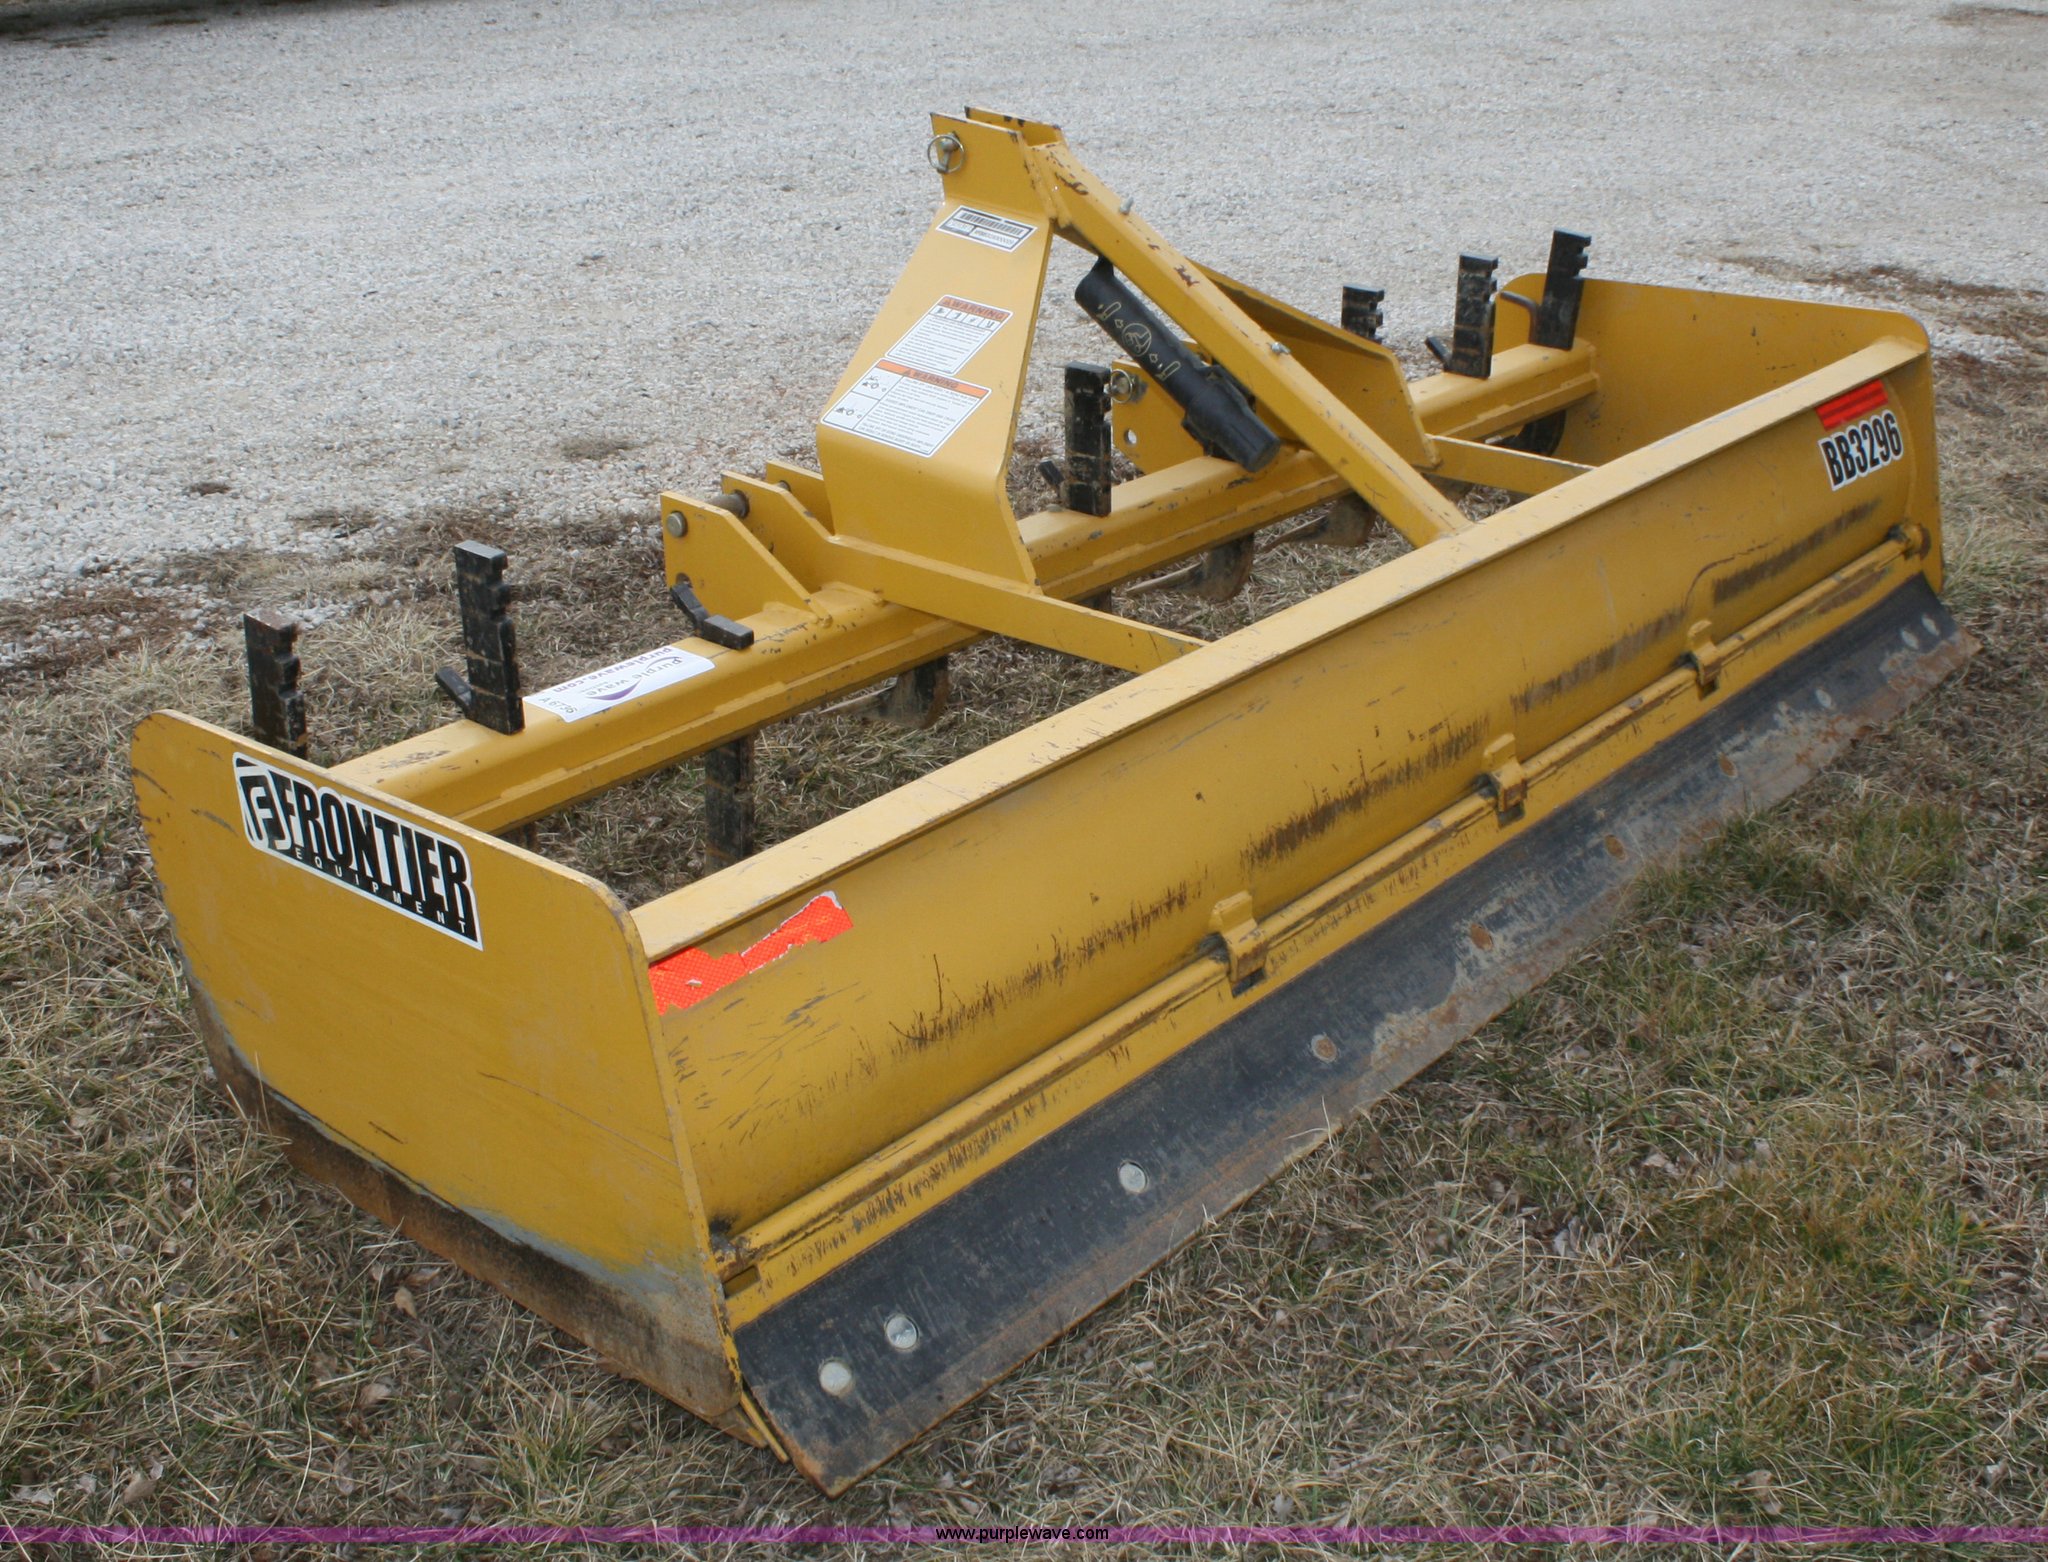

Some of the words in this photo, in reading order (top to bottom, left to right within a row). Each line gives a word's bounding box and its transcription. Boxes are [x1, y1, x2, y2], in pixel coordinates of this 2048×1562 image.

[911, 371, 958, 390] WARNING
[1820, 412, 1904, 486] BB3296
[553, 647, 672, 693] purplewave.com
[586, 678, 629, 697] wave
[632, 657, 682, 680] purple
[267, 770, 477, 925] FRONTIER
[295, 846, 466, 934] EQUIPMENT
